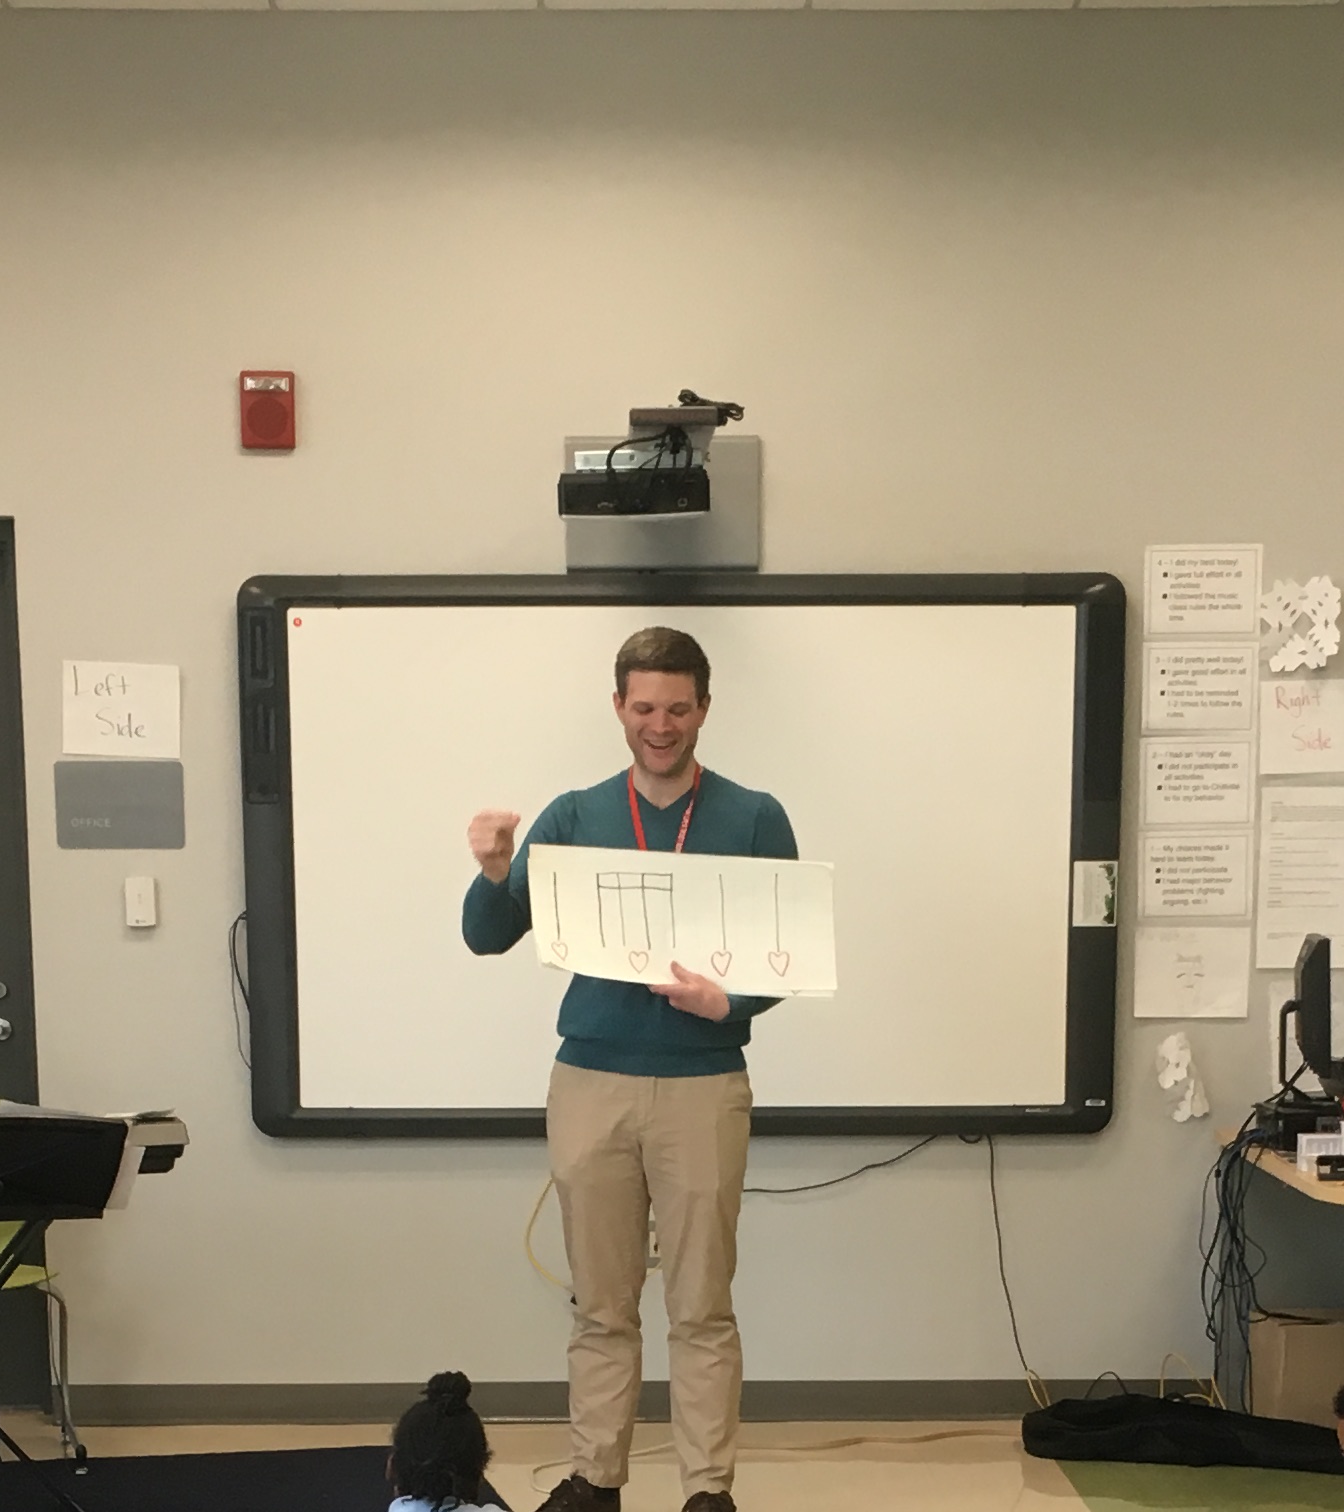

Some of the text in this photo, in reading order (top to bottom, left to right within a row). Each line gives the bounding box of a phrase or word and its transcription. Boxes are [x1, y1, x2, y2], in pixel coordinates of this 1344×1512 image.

[72, 665, 131, 696] Left
[1275, 686, 1321, 717] Right
[95, 706, 147, 738] Side
[1292, 725, 1332, 750] Side
[70, 817, 112, 828] OFFICE
